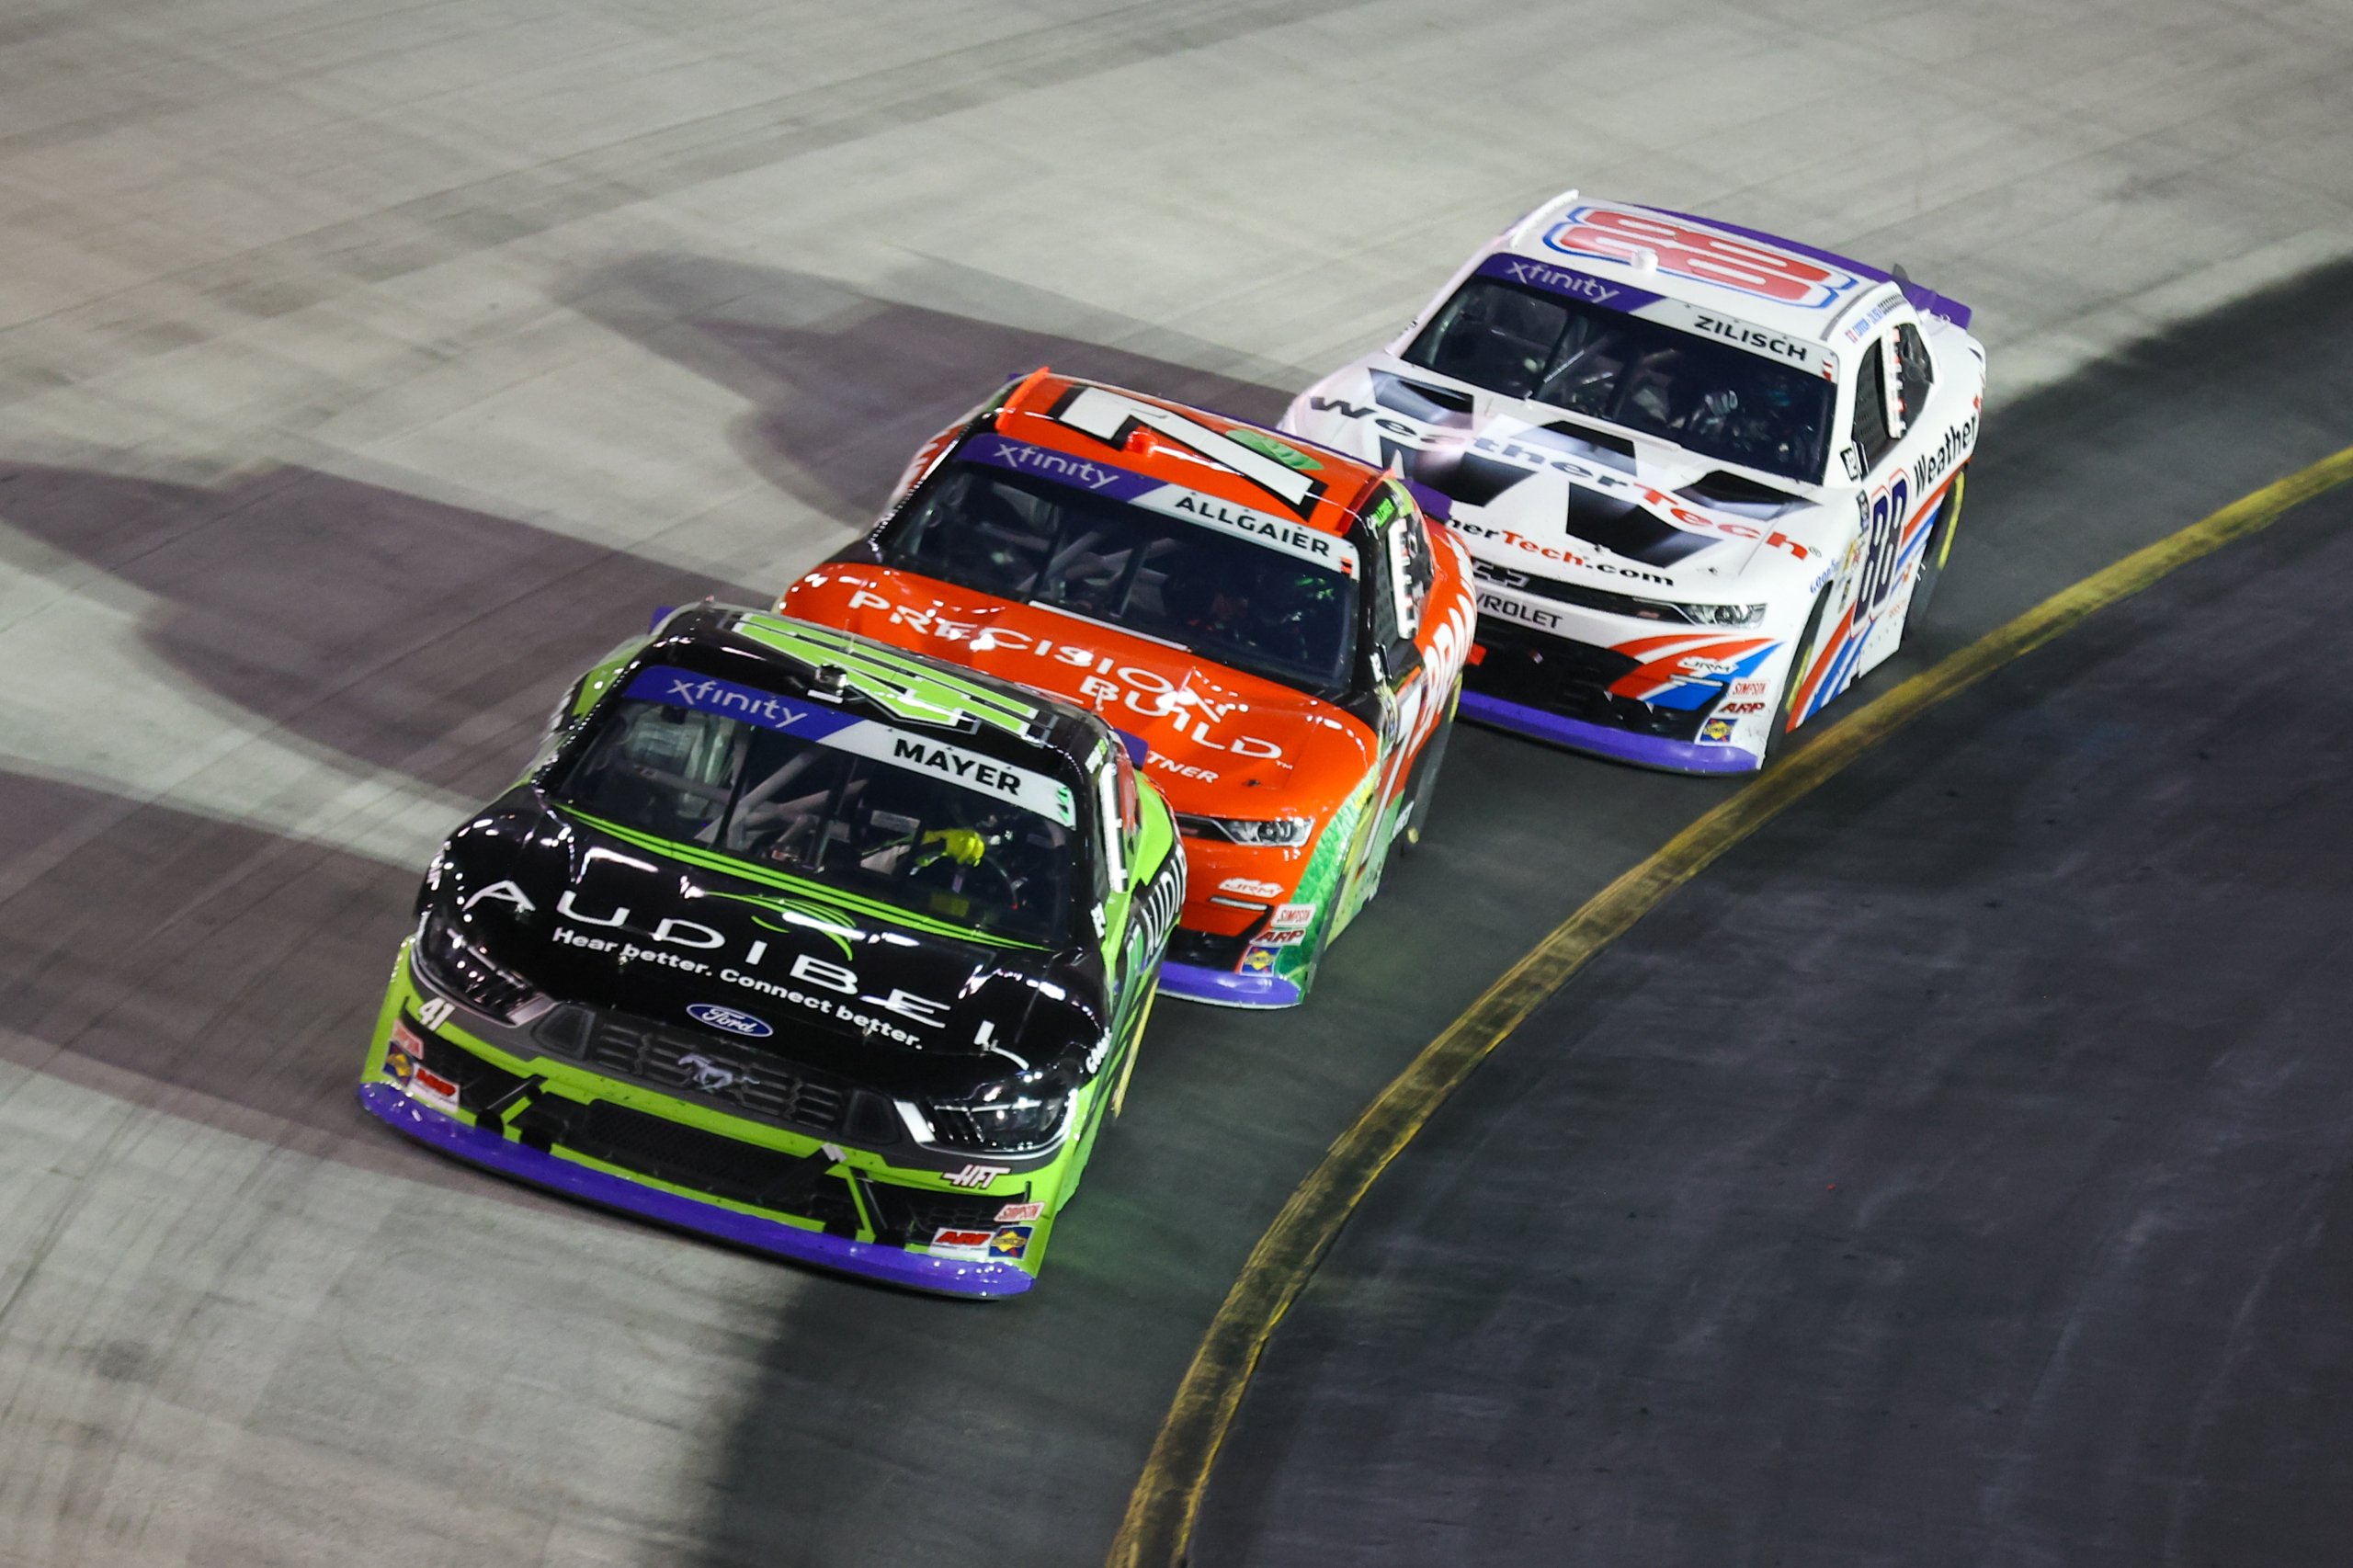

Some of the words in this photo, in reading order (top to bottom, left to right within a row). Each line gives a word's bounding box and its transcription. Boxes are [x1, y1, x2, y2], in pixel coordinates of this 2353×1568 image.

[1506, 260, 1620, 304] xfinity
[1694, 314, 1808, 361] ZILISCH
[992, 442, 1120, 489] xfinity
[1052, 382, 1324, 517] 7
[1914, 409, 1978, 497] Weather
[1310, 395, 1809, 561] WeatherTech
[1176, 495, 1330, 557] ALLGAIER
[1850, 477, 1909, 627] 88
[1476, 593, 1563, 630] ROLET
[847, 588, 1241, 722] PRECISION
[666, 678, 808, 728] xfinity
[1078, 673, 1284, 761] BUILD
[1718, 701, 1767, 714] ARP
[893, 739, 1022, 791] MAYER
[1147, 750, 1221, 785] TNER
[1255, 929, 1305, 942] ARP
[461, 880, 1029, 1070] AUDIBEL
[551, 926, 620, 953] Hear
[619, 942, 713, 977] better.
[719, 967, 833, 1014] Connect
[835, 1005, 924, 1051] better.
[419, 997, 456, 1032] 41
[699, 1005, 757, 1034] Ford
